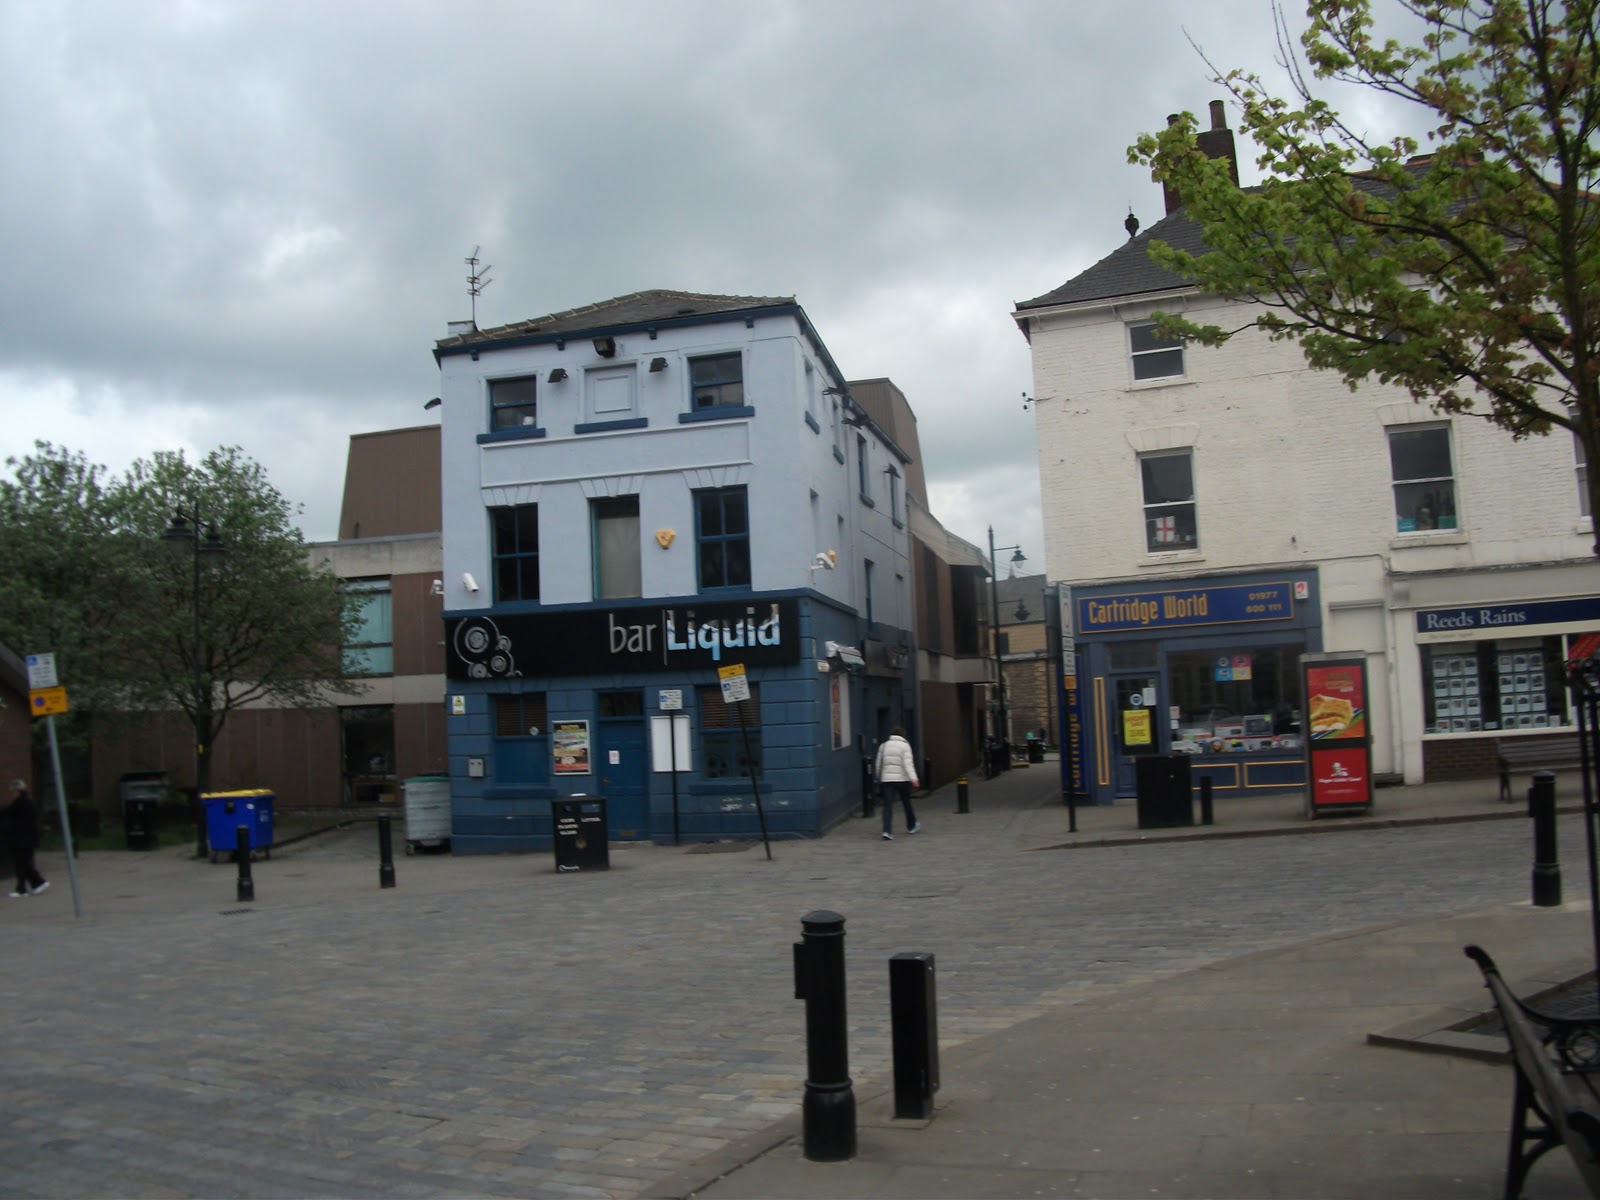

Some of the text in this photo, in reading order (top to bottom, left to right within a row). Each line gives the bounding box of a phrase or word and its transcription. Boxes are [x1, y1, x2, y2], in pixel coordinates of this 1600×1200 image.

[1088, 593, 1208, 625] Cartridge World
[1426, 609, 1527, 629] Reeds Rains
[609, 604, 781, 661] bar Liquid
